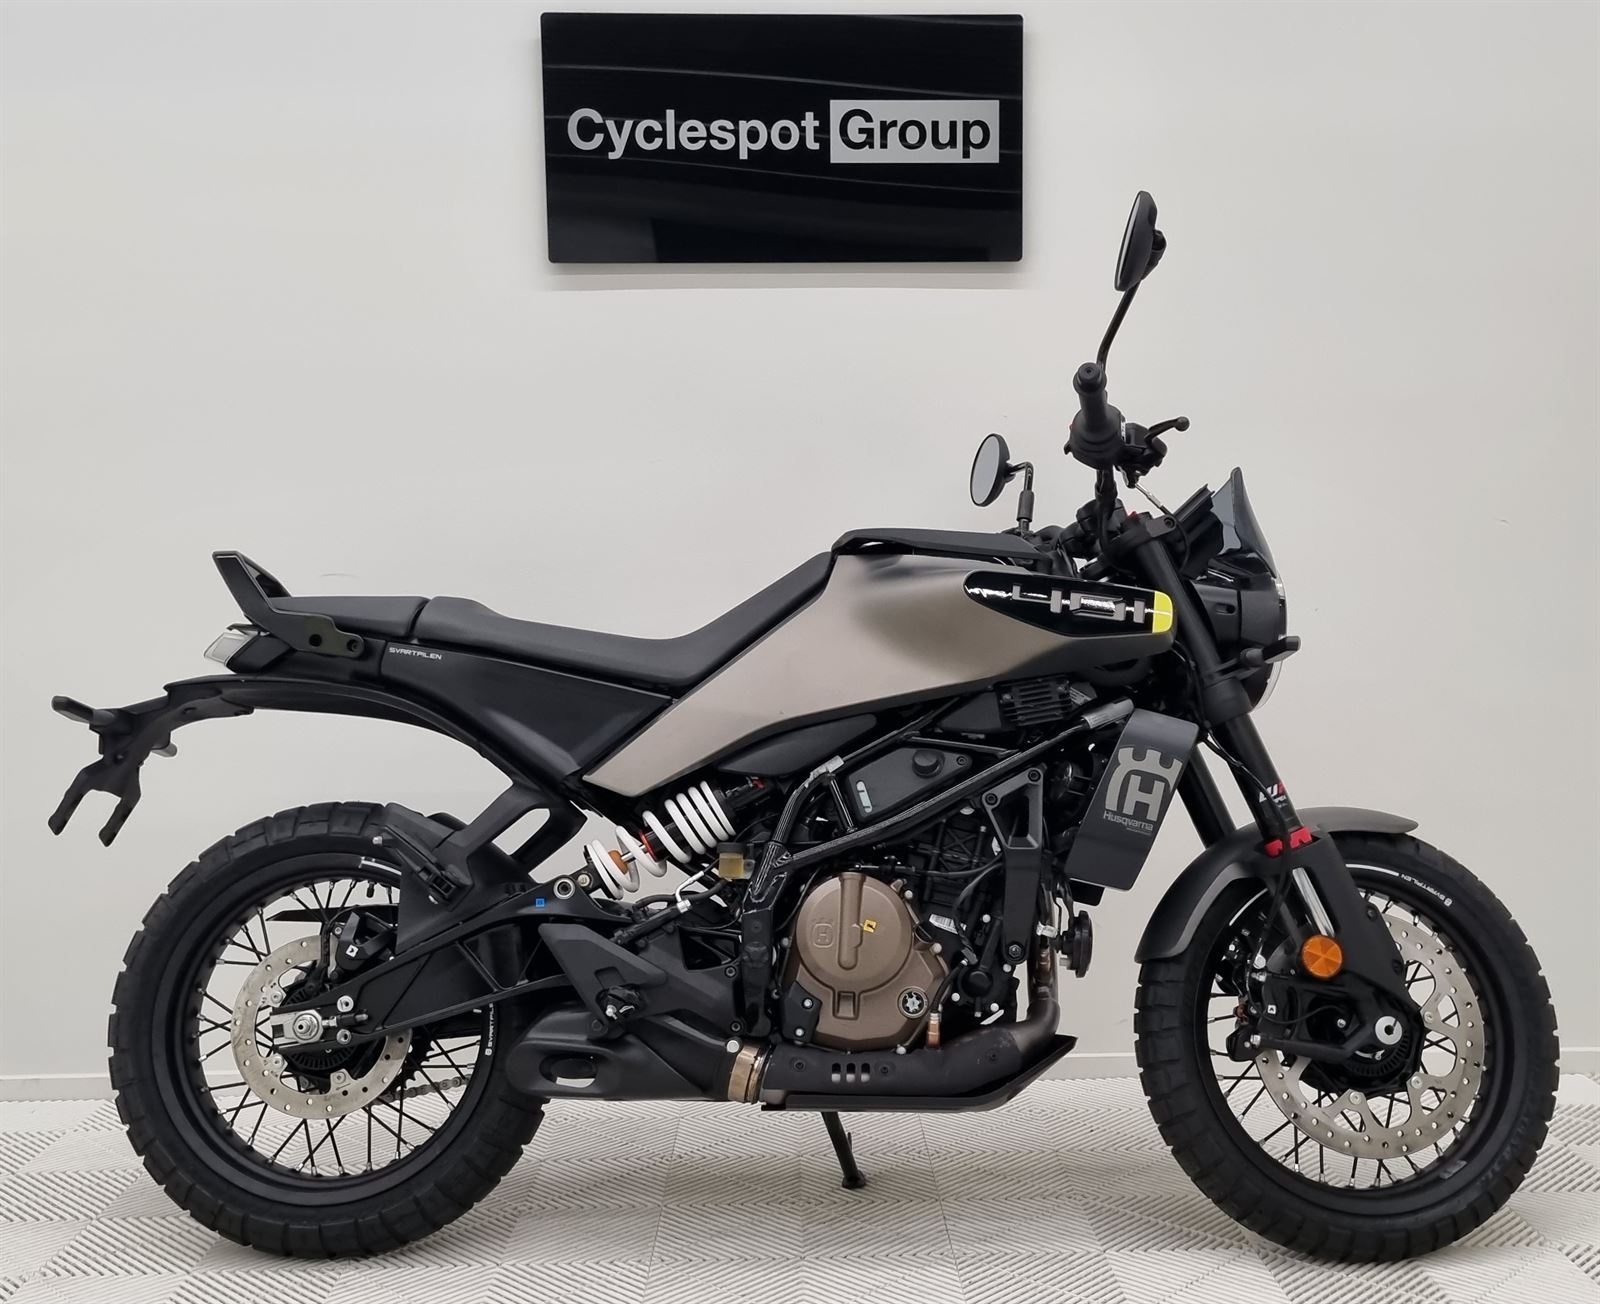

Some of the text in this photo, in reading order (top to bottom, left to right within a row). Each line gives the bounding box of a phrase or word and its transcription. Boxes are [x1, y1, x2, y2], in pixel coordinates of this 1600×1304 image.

[567, 107, 991, 160] Cyclespot Group
[388, 646, 442, 661] SVARTPILEN
[1103, 810, 1154, 832] Husqvarna
[1400, 872, 1446, 902] SVARTPILEN
[487, 1002, 495, 1048] SVARTPILE
